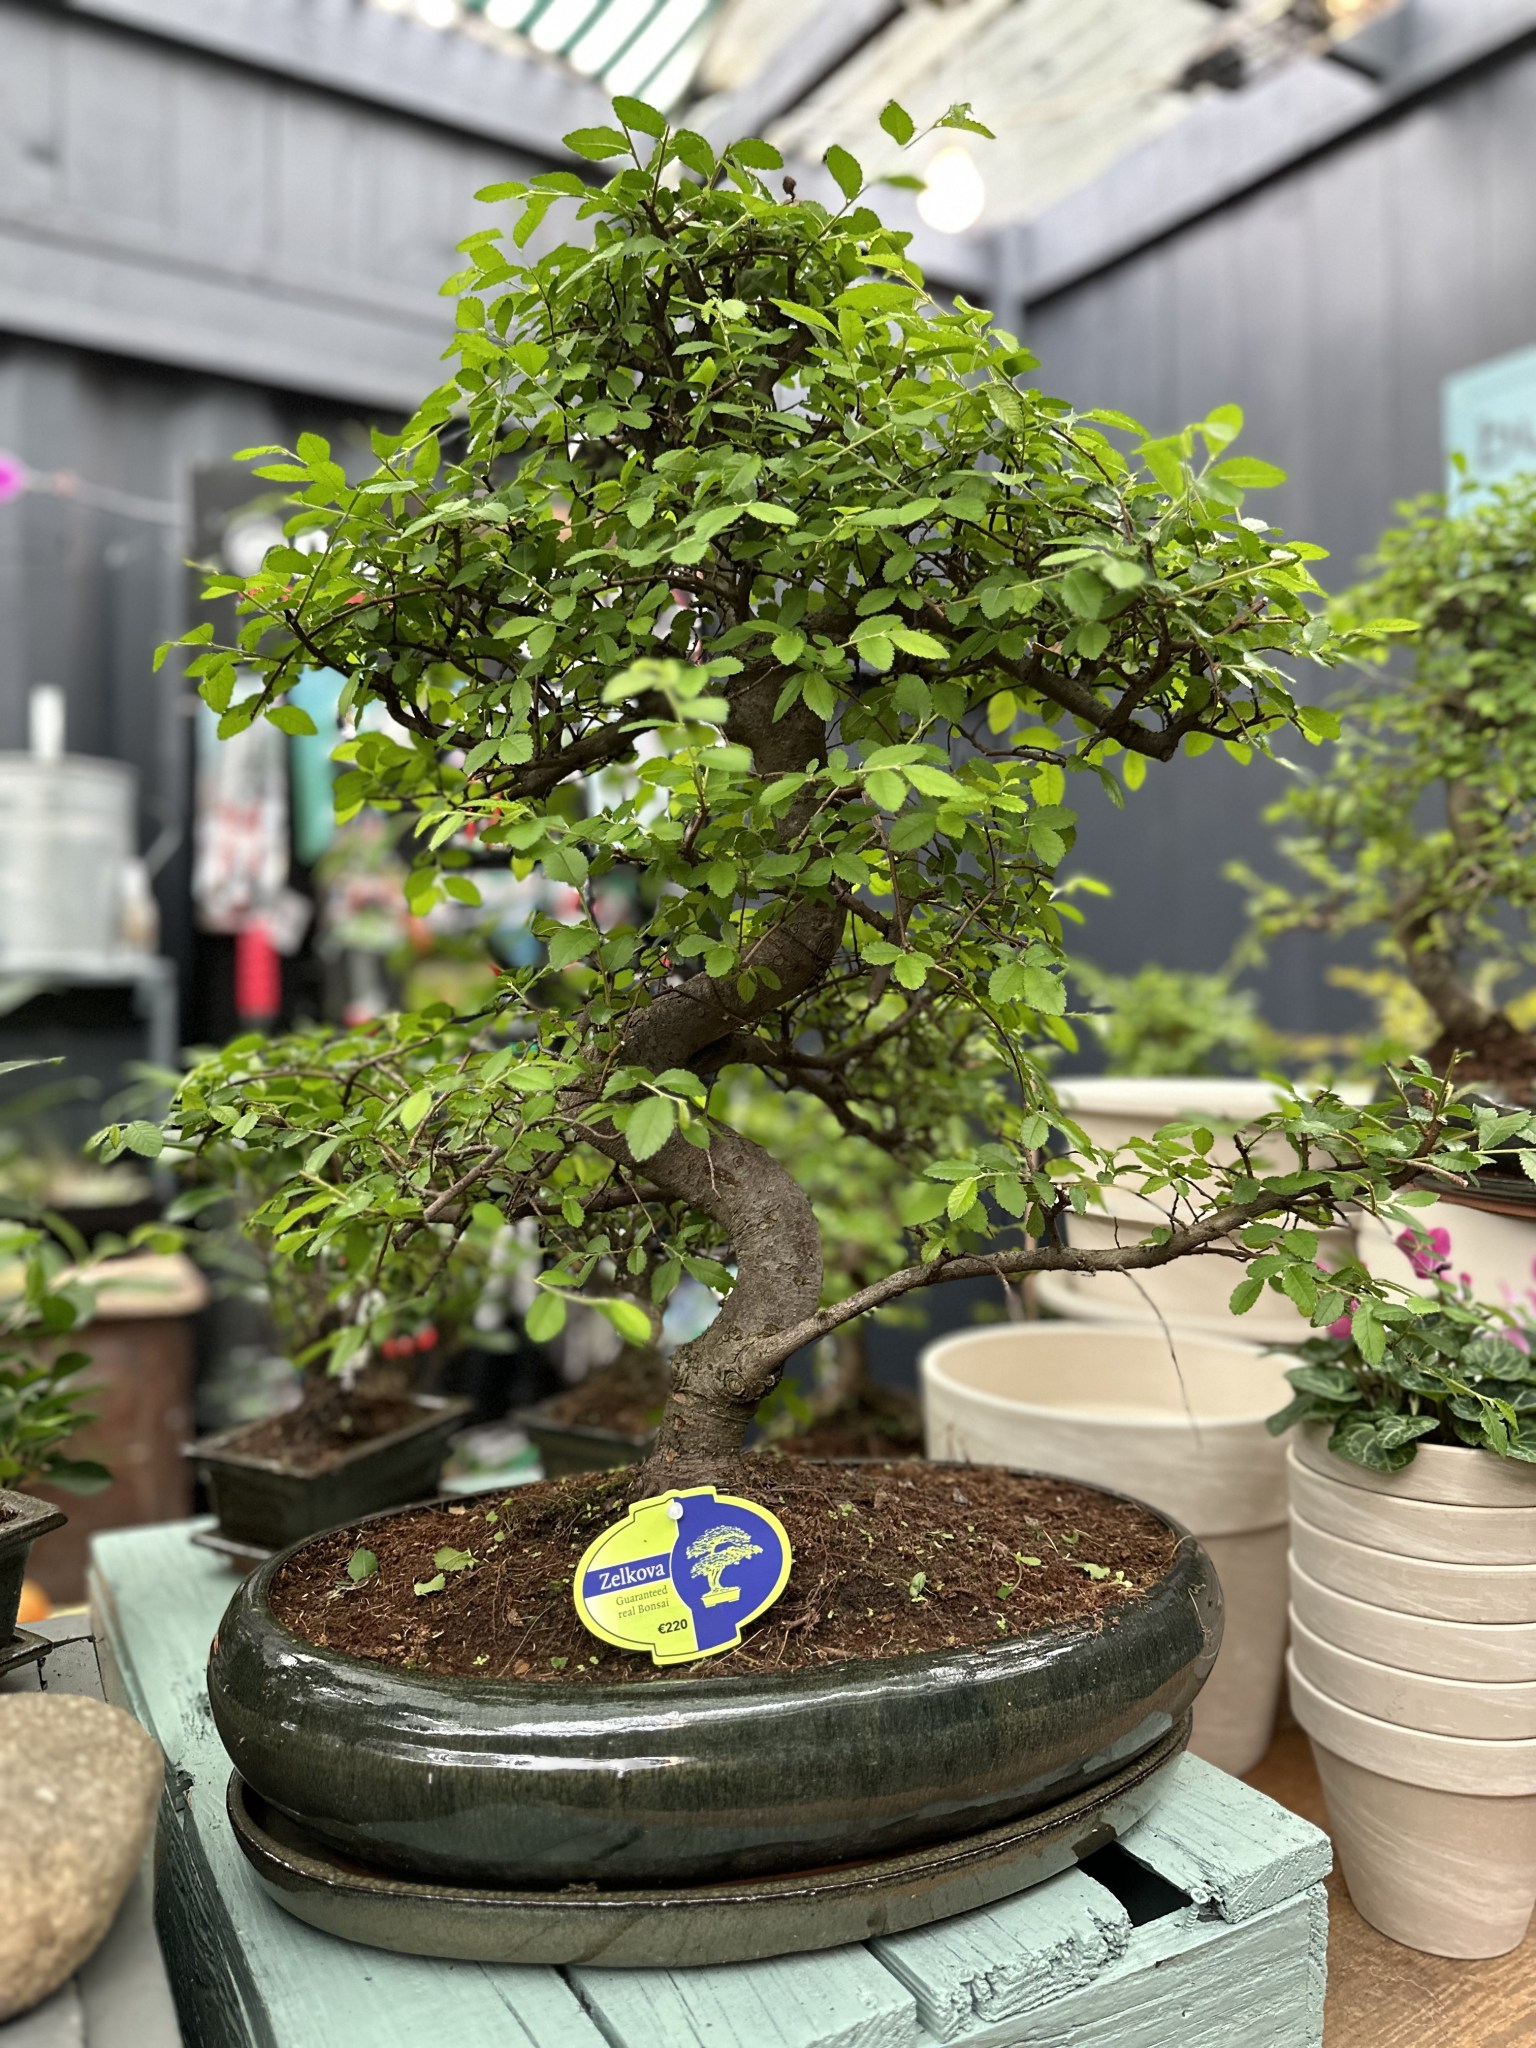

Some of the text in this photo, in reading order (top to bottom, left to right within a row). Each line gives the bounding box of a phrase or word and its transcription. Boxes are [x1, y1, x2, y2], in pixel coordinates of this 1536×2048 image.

[599, 1563, 666, 1590] Zelkova
[615, 1585, 668, 1606] Guaranteed
[618, 1599, 670, 1619] real Bonsai
[657, 1618, 688, 1635] €220
